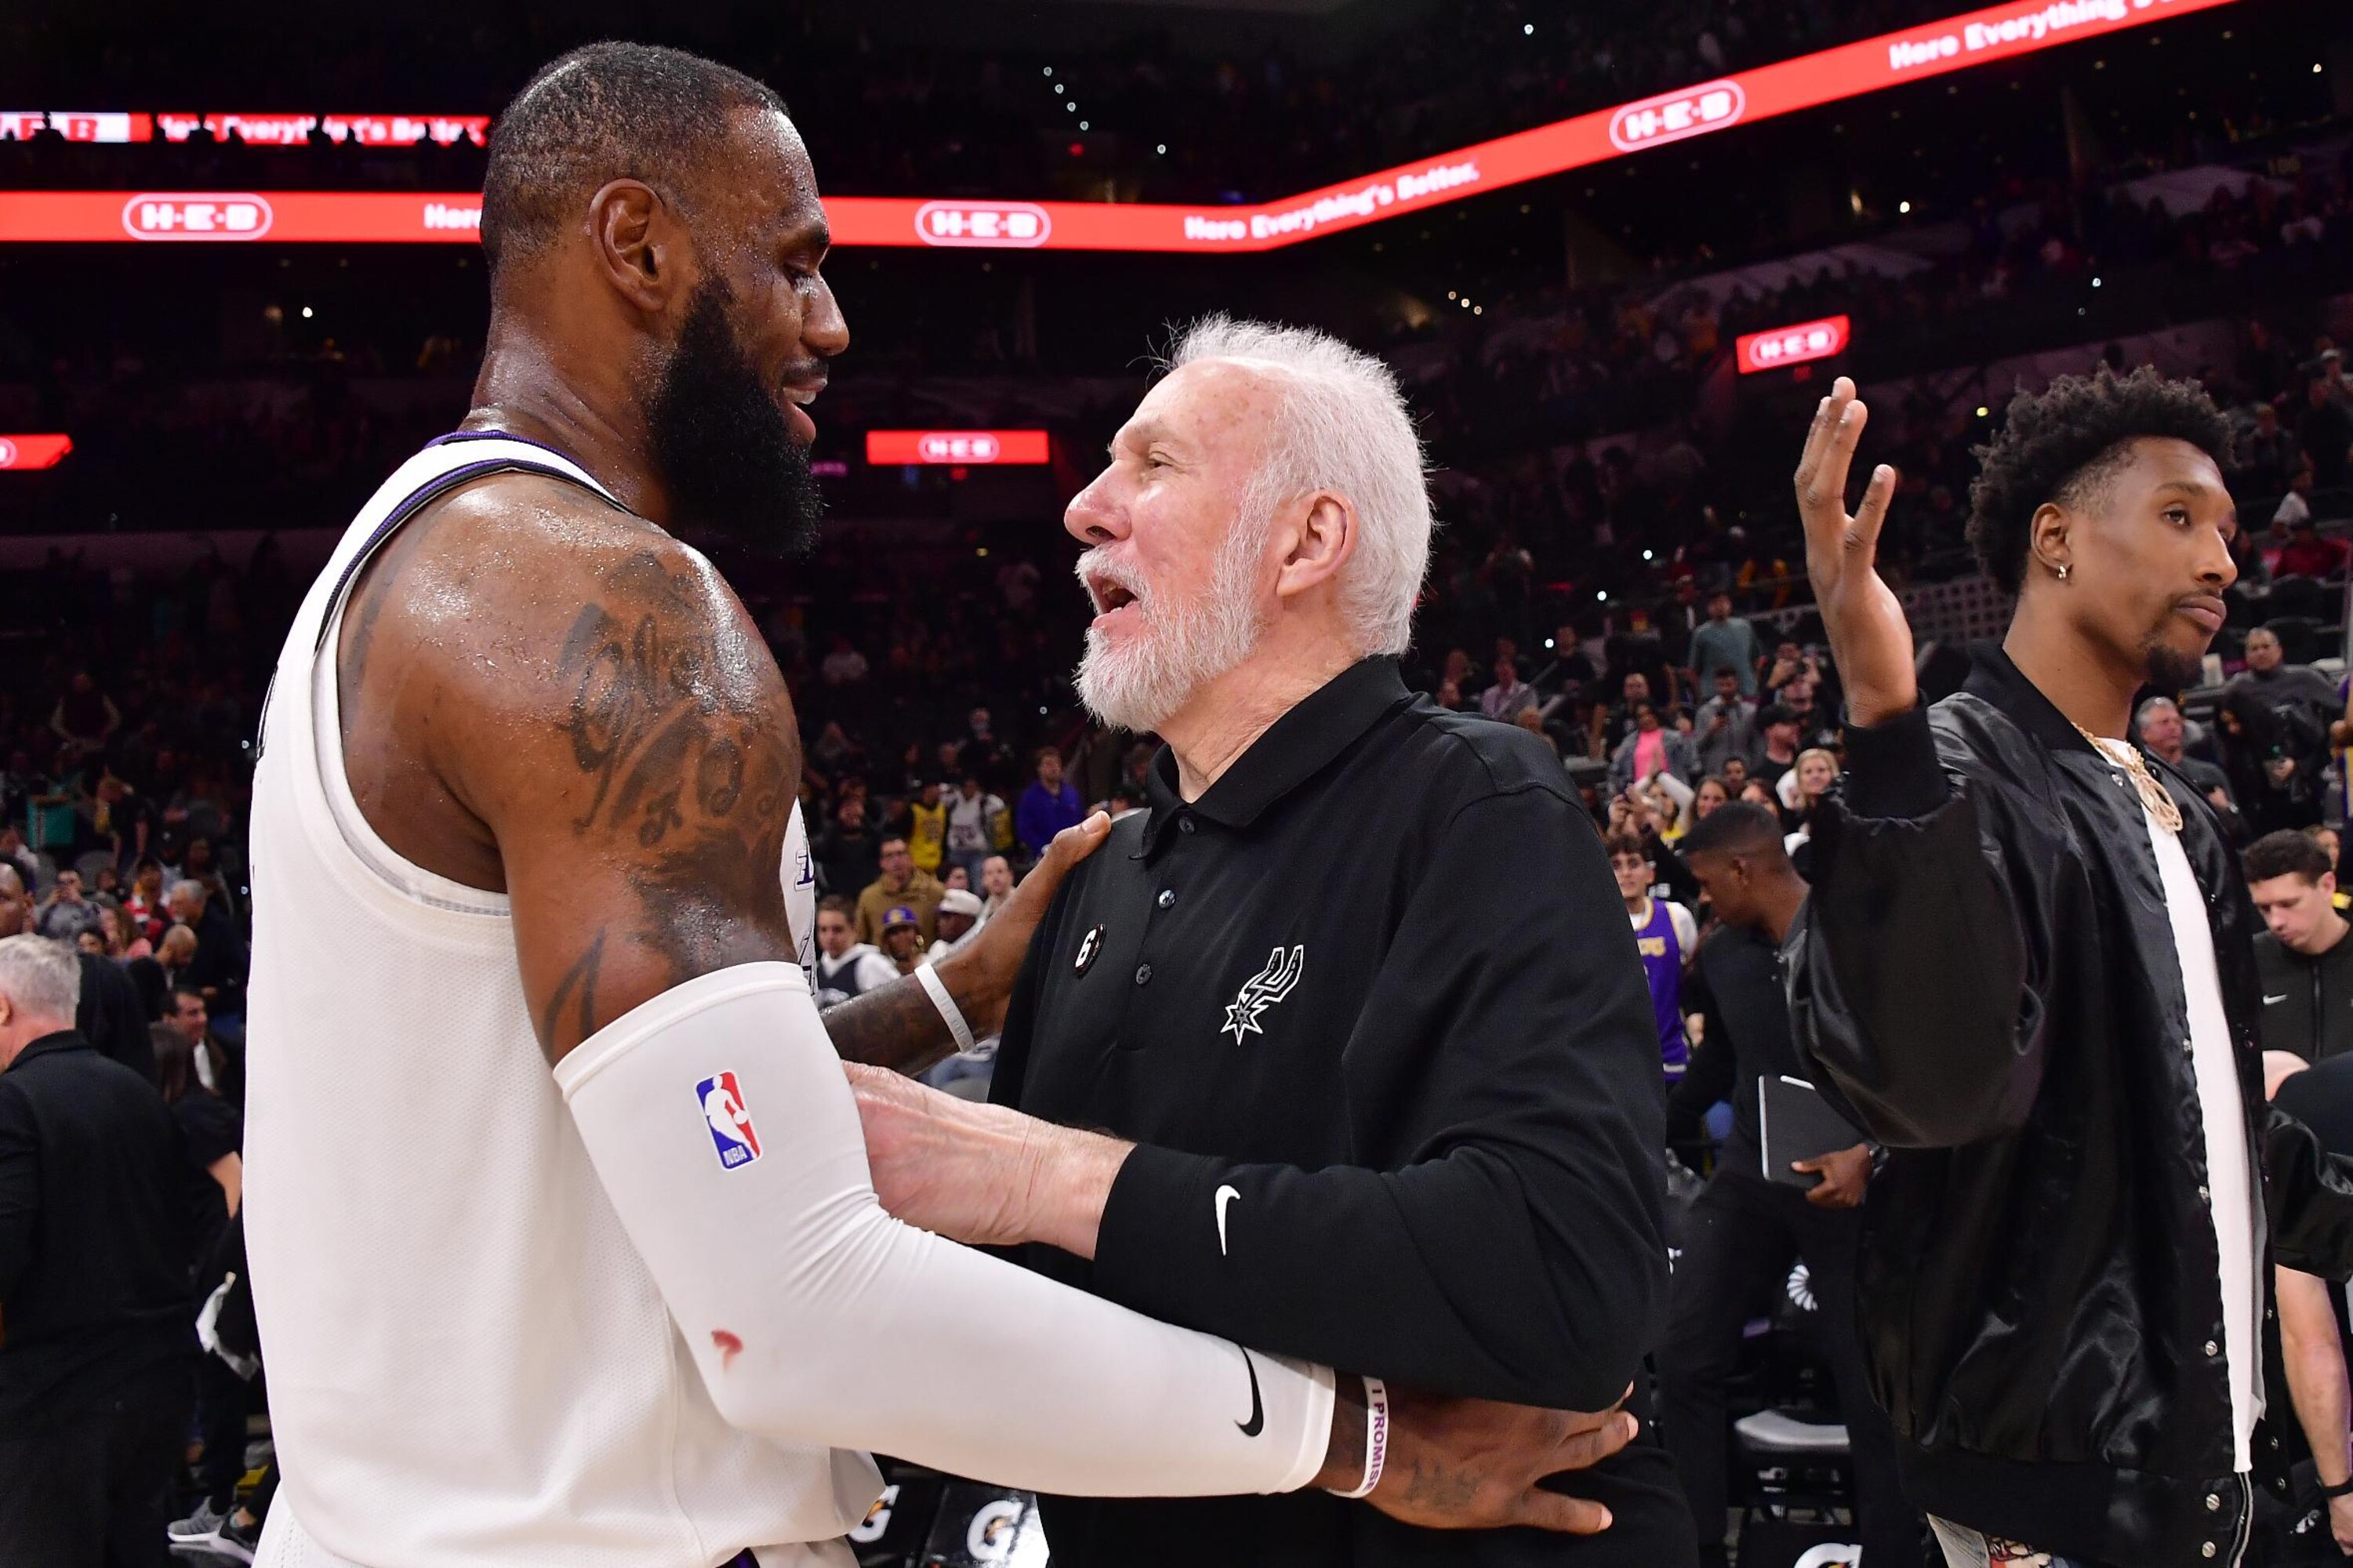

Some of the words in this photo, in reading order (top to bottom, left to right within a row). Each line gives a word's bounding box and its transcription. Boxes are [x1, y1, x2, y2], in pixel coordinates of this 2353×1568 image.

[1889, 35, 1960, 69] Here
[1963, 0, 2153, 50] Everything
[1184, 216, 1247, 240] Here
[722, 1145, 748, 1167] NBA
[1365, 1402, 1389, 1490] PROMISE
